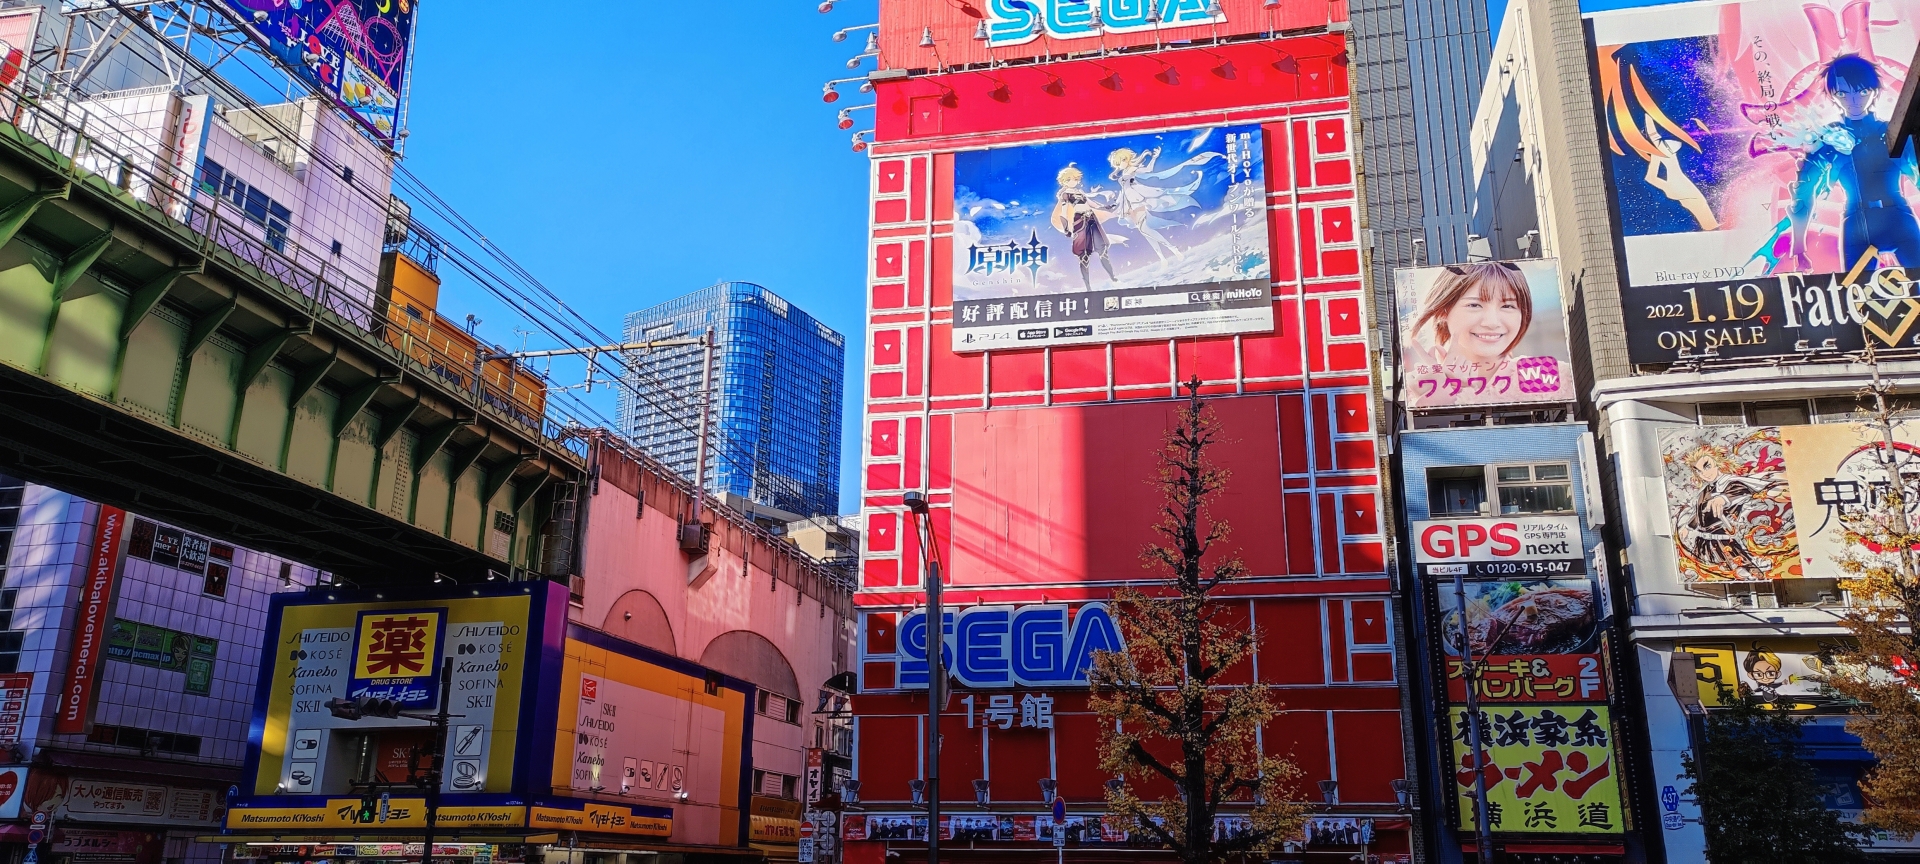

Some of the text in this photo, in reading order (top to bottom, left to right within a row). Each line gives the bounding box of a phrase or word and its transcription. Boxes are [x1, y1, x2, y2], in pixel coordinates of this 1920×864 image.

[299, 27, 341, 70] LOVE
[1240, 132, 1255, 218] miHoYoが贈る
[1225, 132, 1243, 274] 新世代オープンワールドRPG
[964, 228, 1048, 288] 原神
[1655, 266, 1745, 284] Blu-ray & DVD
[1202, 292, 1221, 301] 検索
[1226, 288, 1262, 299] miHoYo
[1775, 272, 1870, 329] Fate
[961, 297, 1091, 323] 好評配信中！
[1646, 283, 1765, 325] 2022 1.19
[1657, 326, 1767, 349] ON SALE
[1416, 360, 1511, 374] 恋愛マッチング
[1418, 375, 1512, 398] ワクワク
[1523, 523, 1569, 531] リアルタイム
[158, 534, 179, 546] LOVE
[1421, 522, 1522, 559] GPS
[1524, 531, 1567, 540] GPS専門店
[1525, 540, 1570, 556] next
[181, 548, 206, 563] 大歓迎
[1431, 565, 1463, 574] 当ビル4F
[1486, 562, 1571, 574] 0120-915-047
[67, 512, 118, 721] www.akibalovemerci.com
[286, 631, 351, 645] SHISEIDO
[452, 625, 520, 638] SHISEIDO
[366, 616, 429, 675] 薬
[478, 641, 513, 655] KOSÉ
[898, 602, 1134, 688] SEGA
[310, 649, 343, 661] KOSÉ
[288, 665, 338, 679] Kanebo
[456, 660, 509, 674] Kanebo
[1448, 658, 1551, 679] ステーキ&
[1694, 653, 1722, 683] 5
[391, 677, 414, 685] STORE
[458, 678, 504, 691] SOFINA
[1472, 677, 1577, 698] ハンバーグ
[289, 683, 333, 696] SOFINA
[295, 700, 321, 713] SK-II
[466, 695, 493, 708] SK-II
[961, 693, 1055, 730] 1号館
[579, 715, 615, 732] SHISEIDO
[1454, 709, 1609, 748] 横浜家系
[589, 735, 608, 749] KOSÉ
[576, 751, 605, 767] Kanebo
[575, 768, 601, 781] SOFINA
[1457, 750, 1610, 799] ラーメン
[74, 784, 144, 802] 大人の通信販売
[1662, 792, 1677, 804] 437
[34, 811, 44, 822] 20
[241, 813, 325, 823] Matsumoto KiYoshi
[337, 805, 411, 824] マツヨシ
[424, 812, 512, 822] tsumoto KiYoshi
[535, 813, 584, 825] Matsumoto KiYoshi
[589, 809, 626, 828] マツモトキヨシ
[1471, 801, 1614, 830] 横浜道
[630, 821, 653, 830] Matsumoto
[64, 836, 117, 848] ラブメルシー
